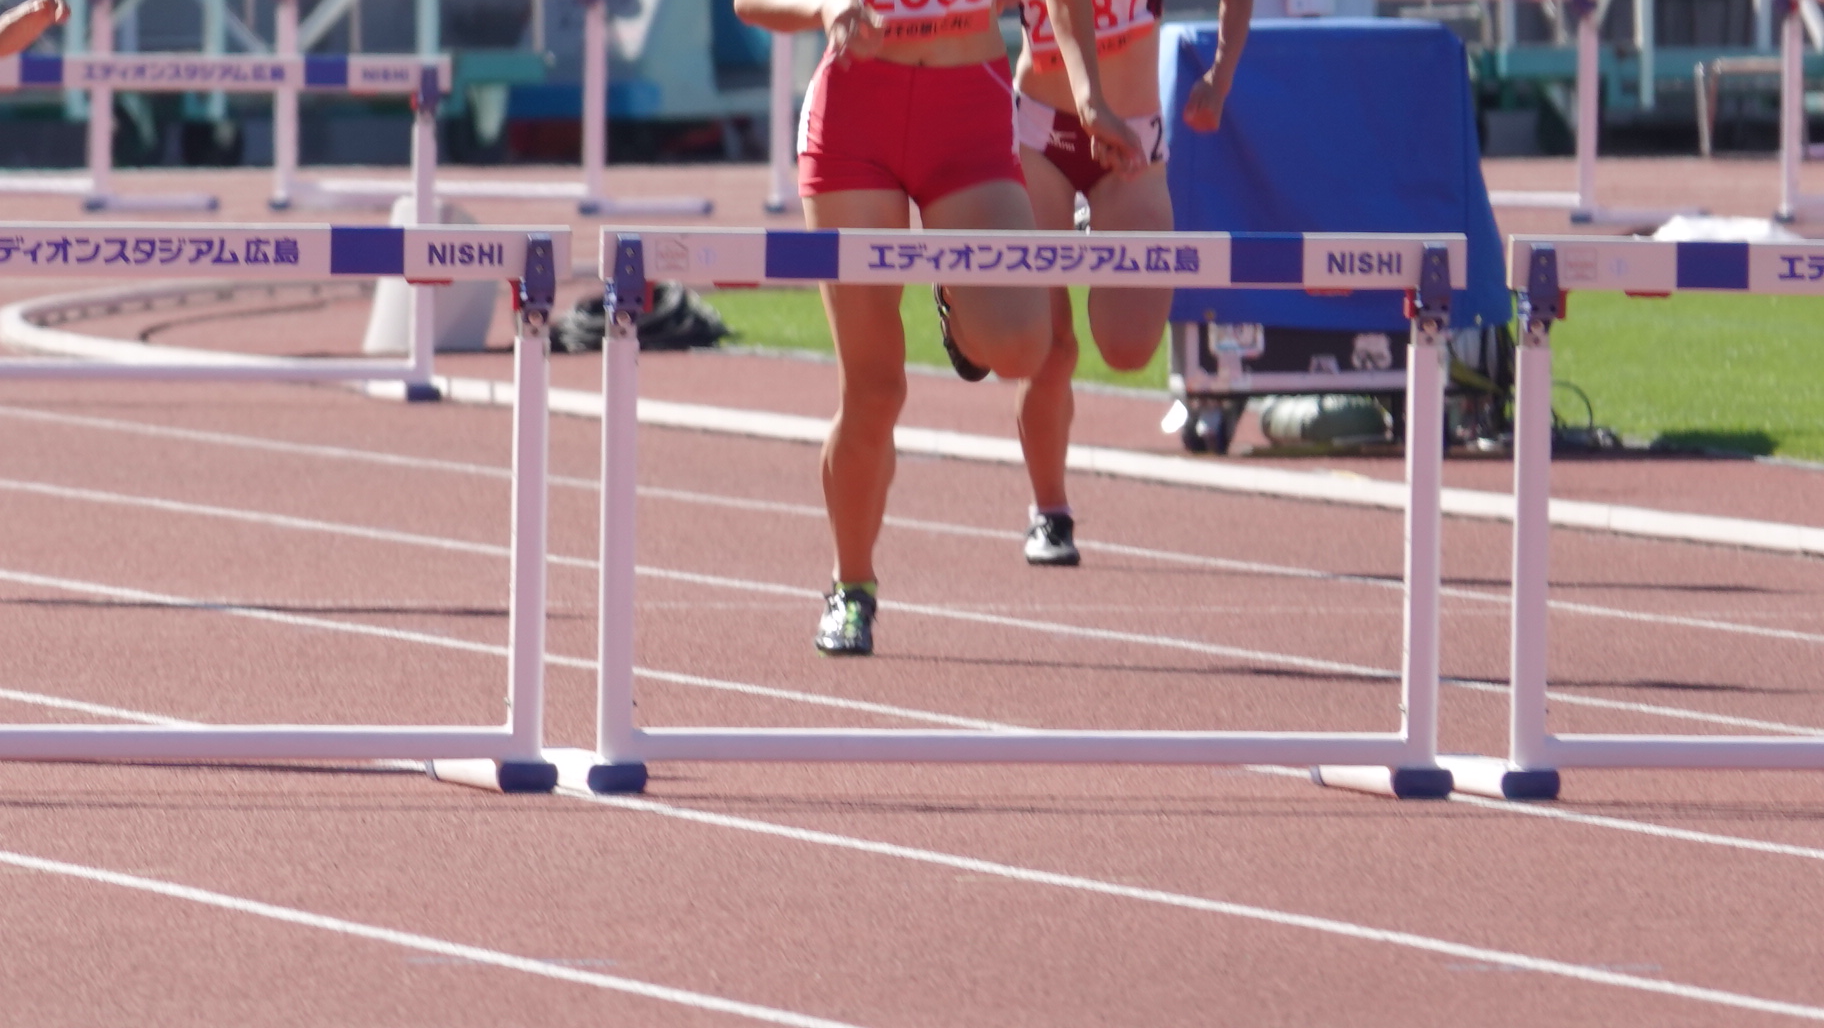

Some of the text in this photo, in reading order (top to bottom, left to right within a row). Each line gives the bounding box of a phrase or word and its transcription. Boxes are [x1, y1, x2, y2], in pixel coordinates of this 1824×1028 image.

[427, 242, 504, 266] NISHI
[868, 244, 1200, 272] エディオンスタジアム広島
[1327, 251, 1402, 274] NISHI
